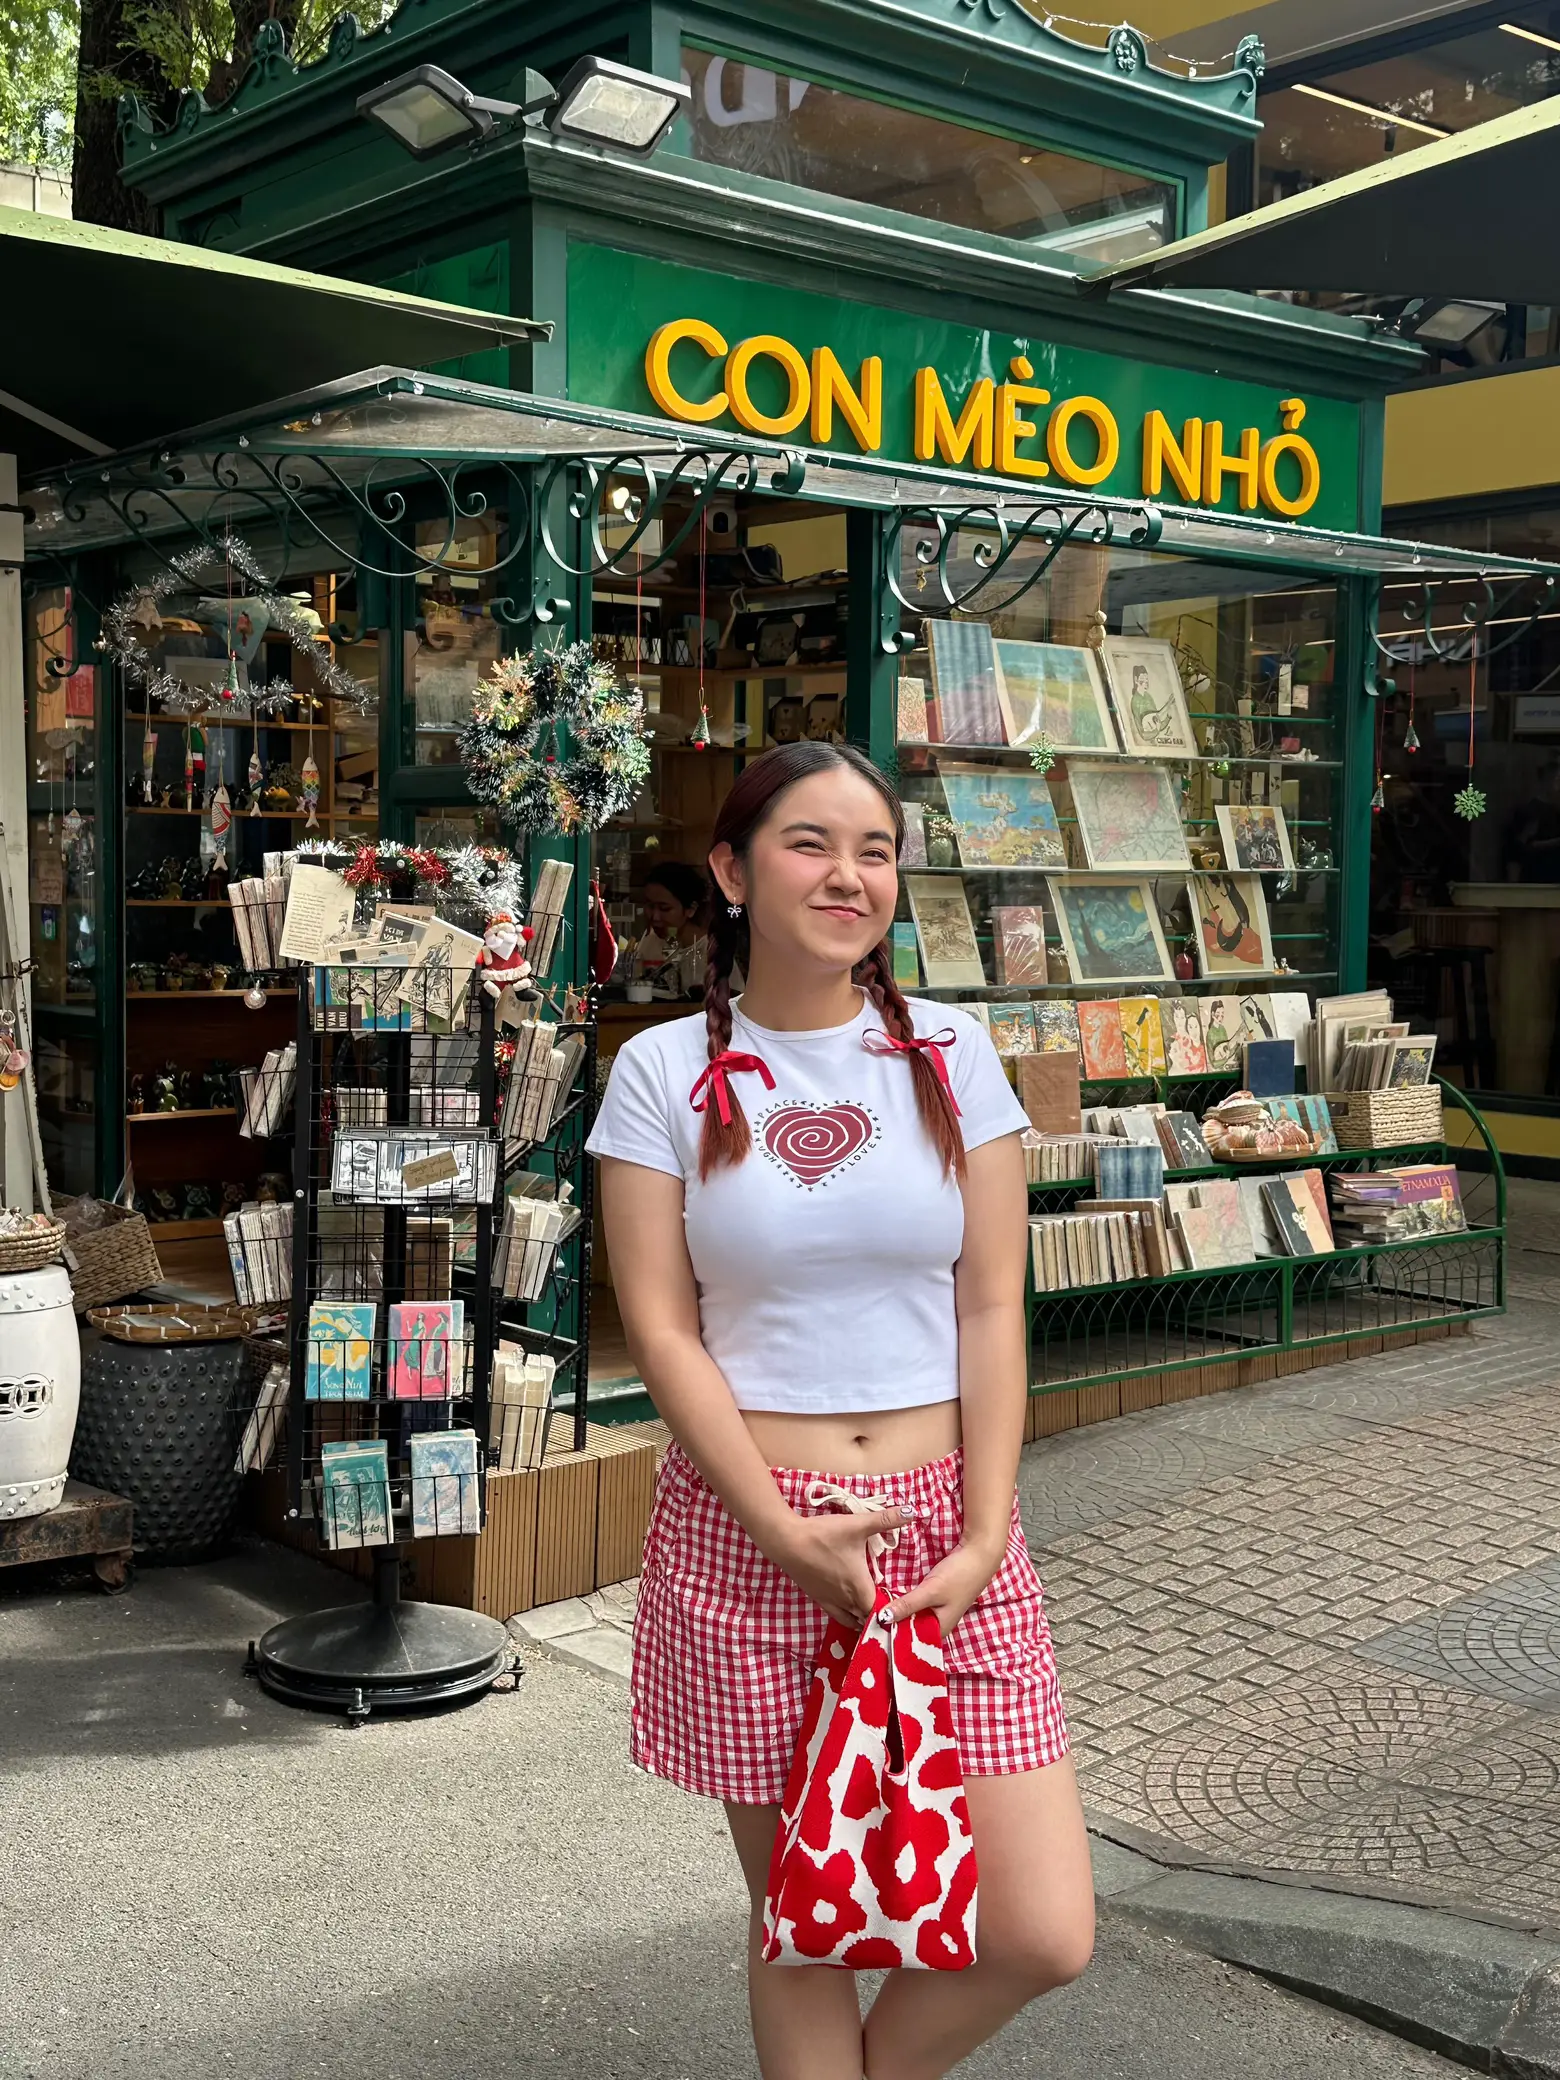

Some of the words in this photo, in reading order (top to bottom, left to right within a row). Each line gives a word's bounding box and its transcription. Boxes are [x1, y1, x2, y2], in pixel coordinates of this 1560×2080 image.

[645, 318, 882, 451] CON
[914, 356, 1119, 485] MÈO
[1142, 398, 1320, 516] NHỎ
[847, 1142, 877, 1167] LOVE
